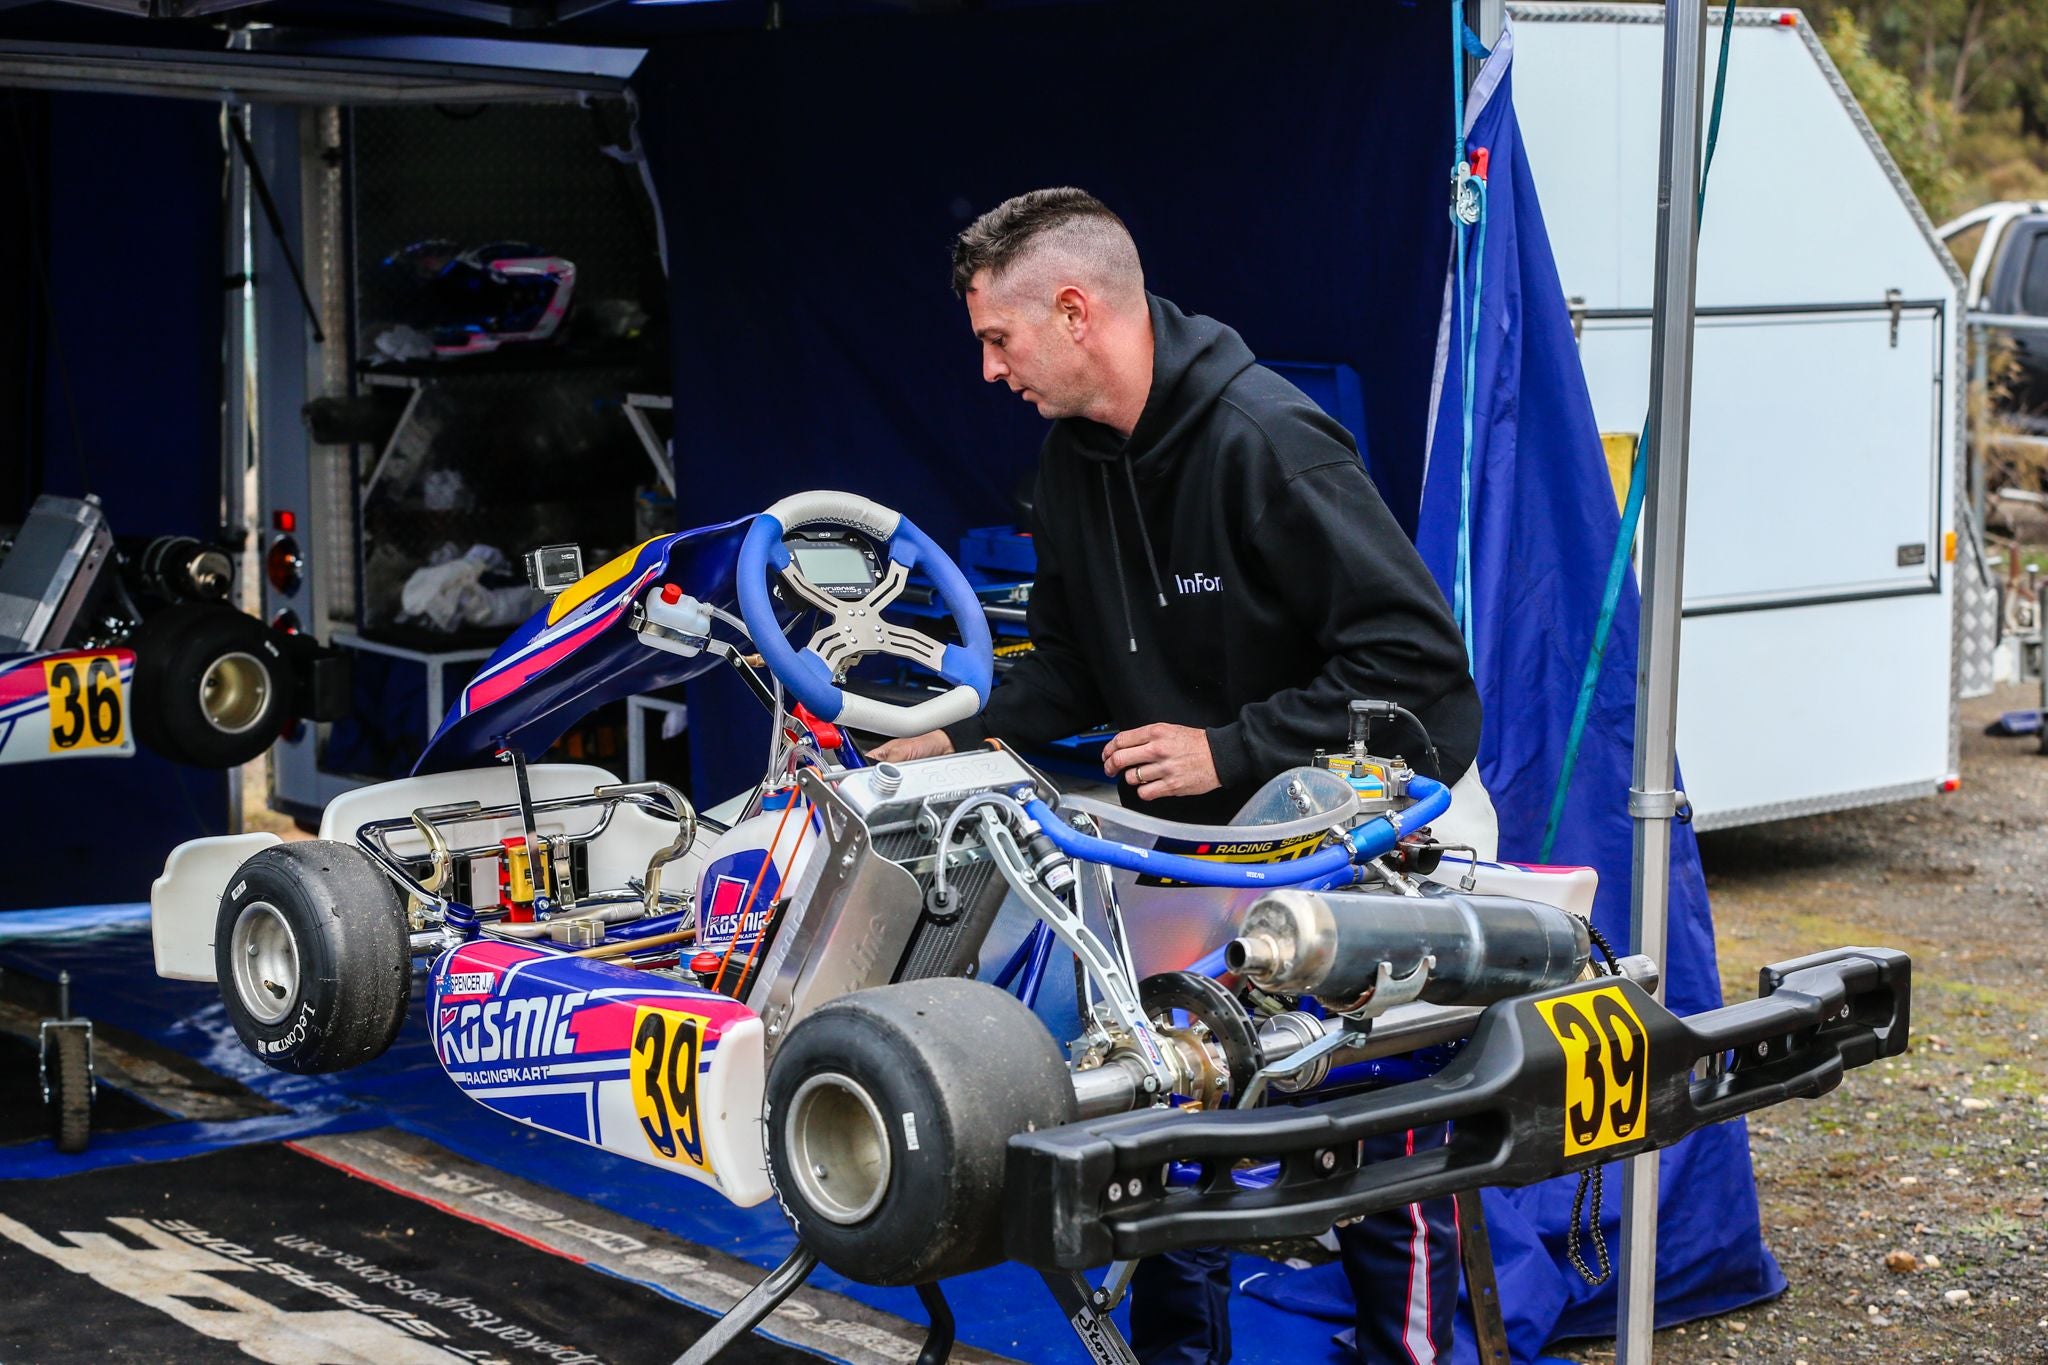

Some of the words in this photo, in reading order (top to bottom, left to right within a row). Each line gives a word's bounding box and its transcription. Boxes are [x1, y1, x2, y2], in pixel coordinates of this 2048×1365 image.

[51, 657, 121, 748] 36
[1215, 841, 1274, 855] RACING
[1279, 832, 1318, 848] SEATS
[450, 974, 482, 992] SPENCER
[440, 991, 588, 1065] KOSMIC
[465, 1069, 510, 1085] RACING
[512, 1065, 550, 1082] KART
[634, 1012, 704, 1166] 39
[1552, 994, 1646, 1146] 39
[151, 1218, 452, 1339] SUPERSTORE
